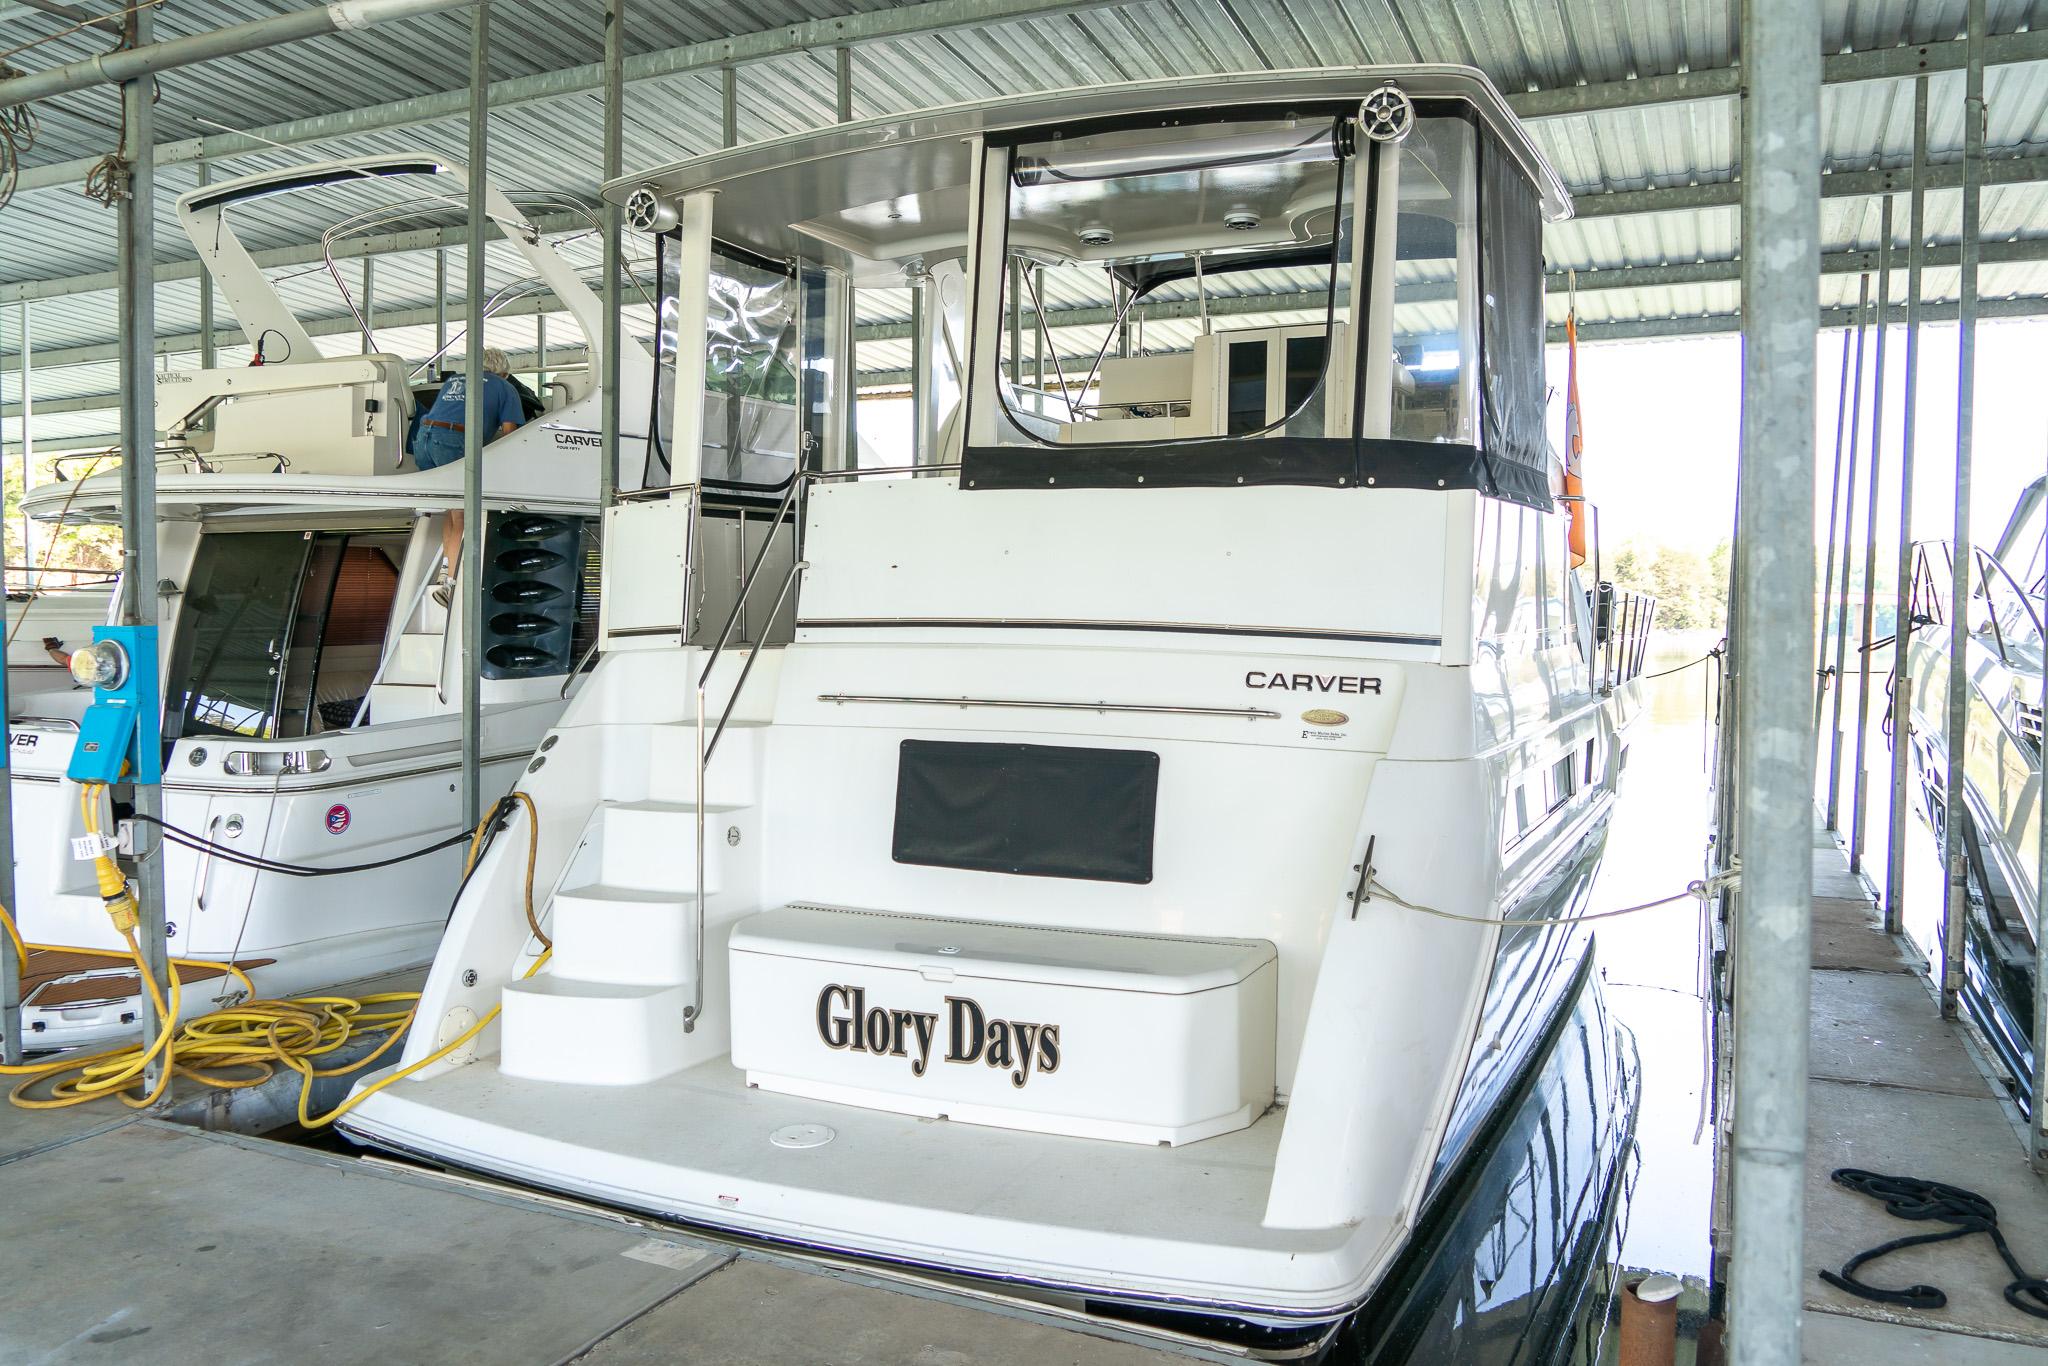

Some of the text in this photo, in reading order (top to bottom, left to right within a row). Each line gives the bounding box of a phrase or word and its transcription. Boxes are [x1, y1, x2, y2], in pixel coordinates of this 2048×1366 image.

[1245, 671, 1382, 695] CARVER
[816, 983, 1061, 1089] Glory Days
